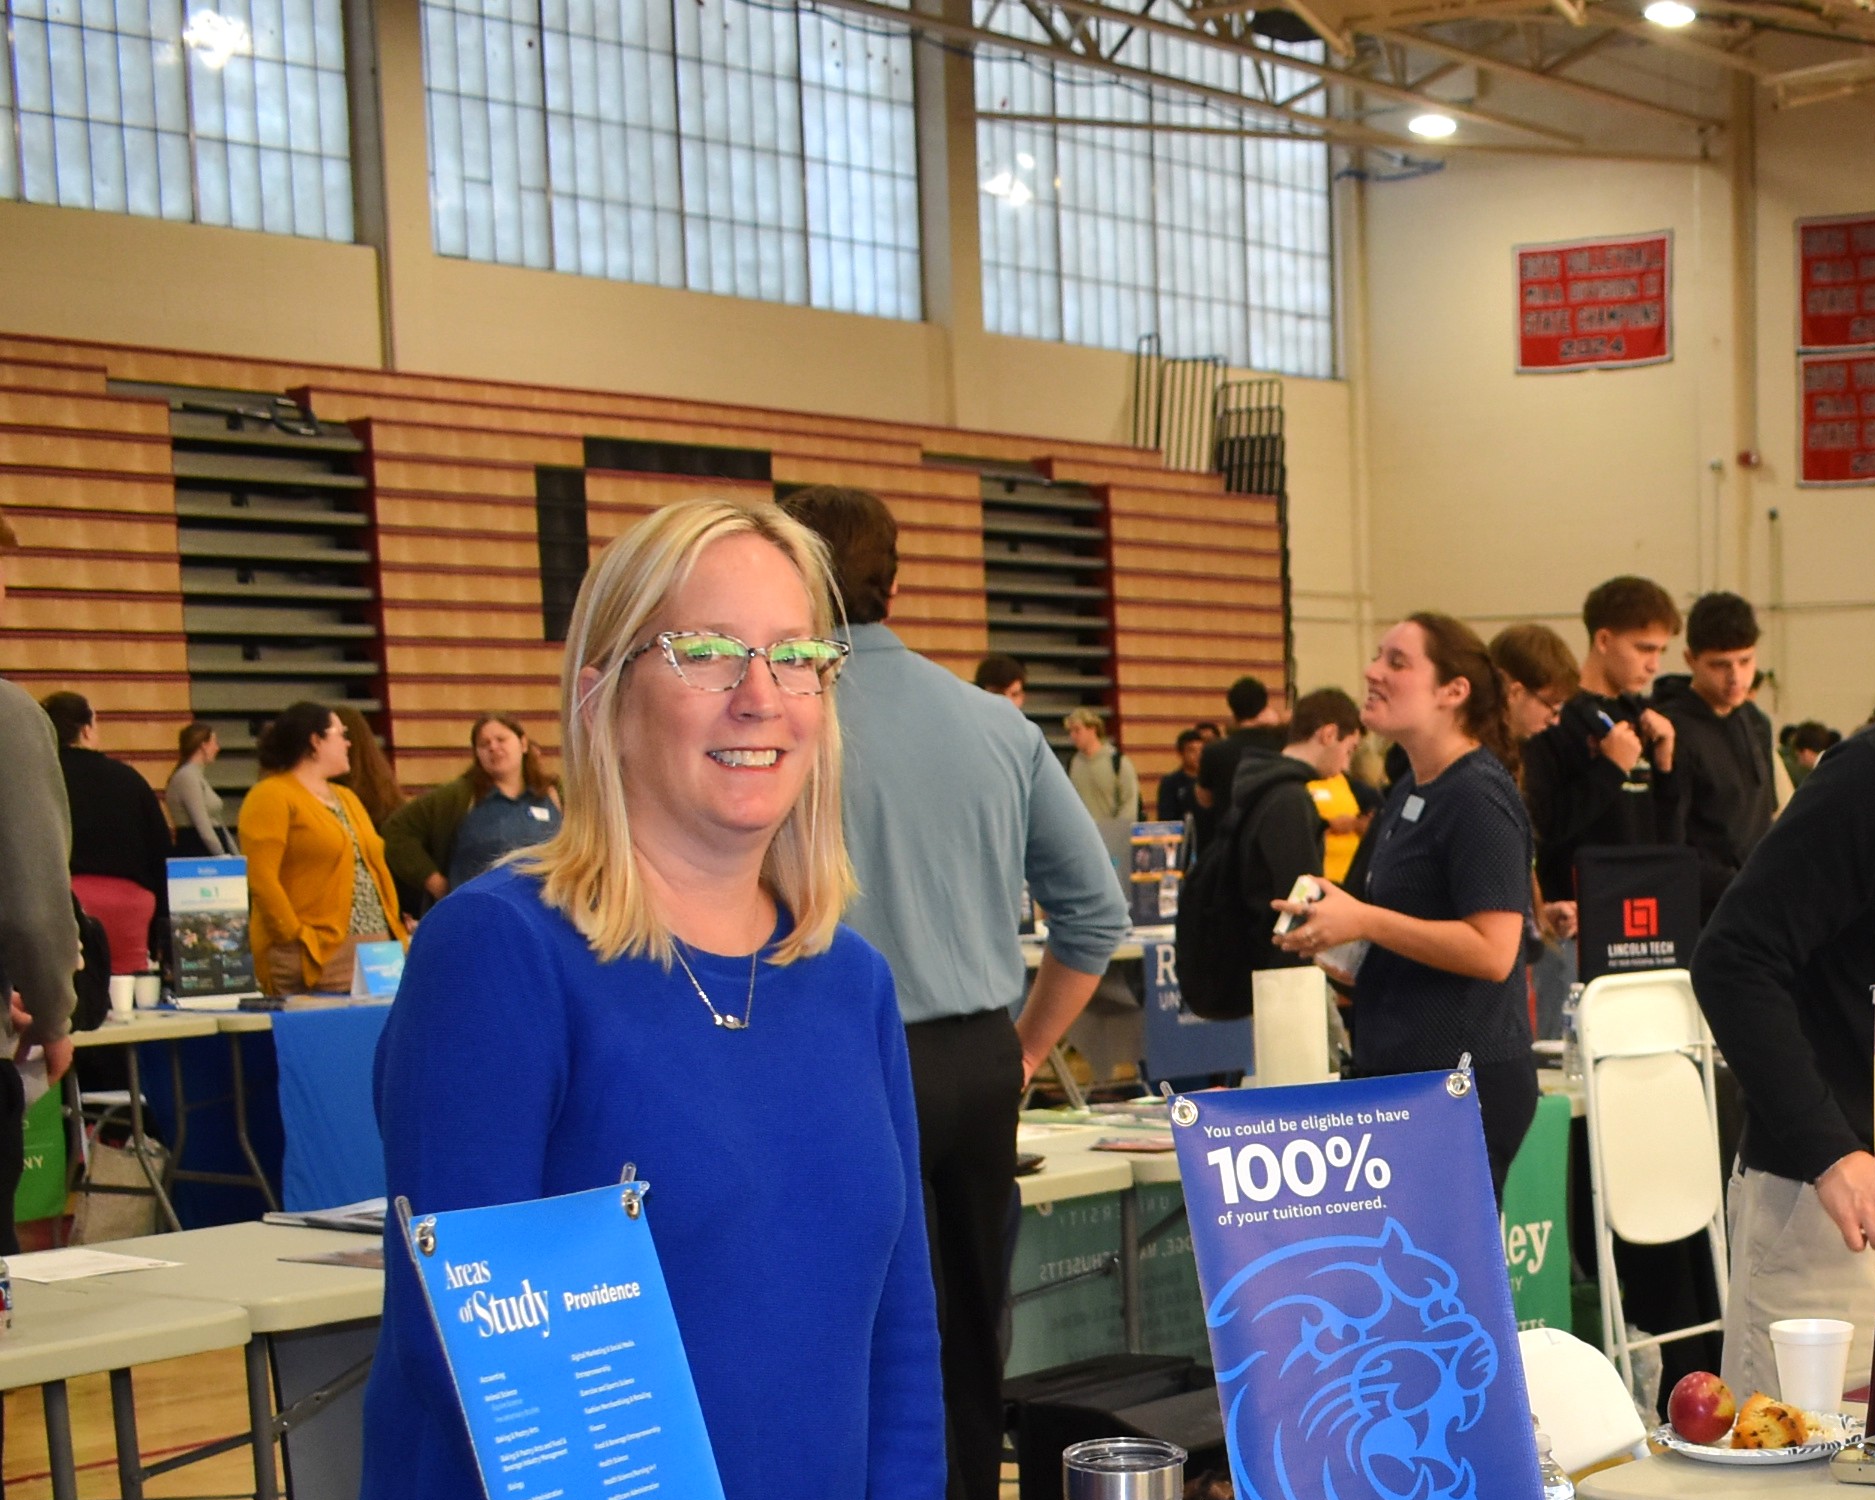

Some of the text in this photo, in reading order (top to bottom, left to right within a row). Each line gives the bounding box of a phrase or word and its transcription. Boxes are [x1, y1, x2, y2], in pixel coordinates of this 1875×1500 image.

[1607, 940, 1675, 958] LINCOLN TECH
[1203, 1109, 1410, 1139] You could be eligible to have
[1205, 1129, 1391, 1207] 100%
[1218, 1195, 1387, 1228] of your tuition covered.
[445, 1260, 641, 1312] Areas Providence
[459, 1277, 550, 1340] of Study
